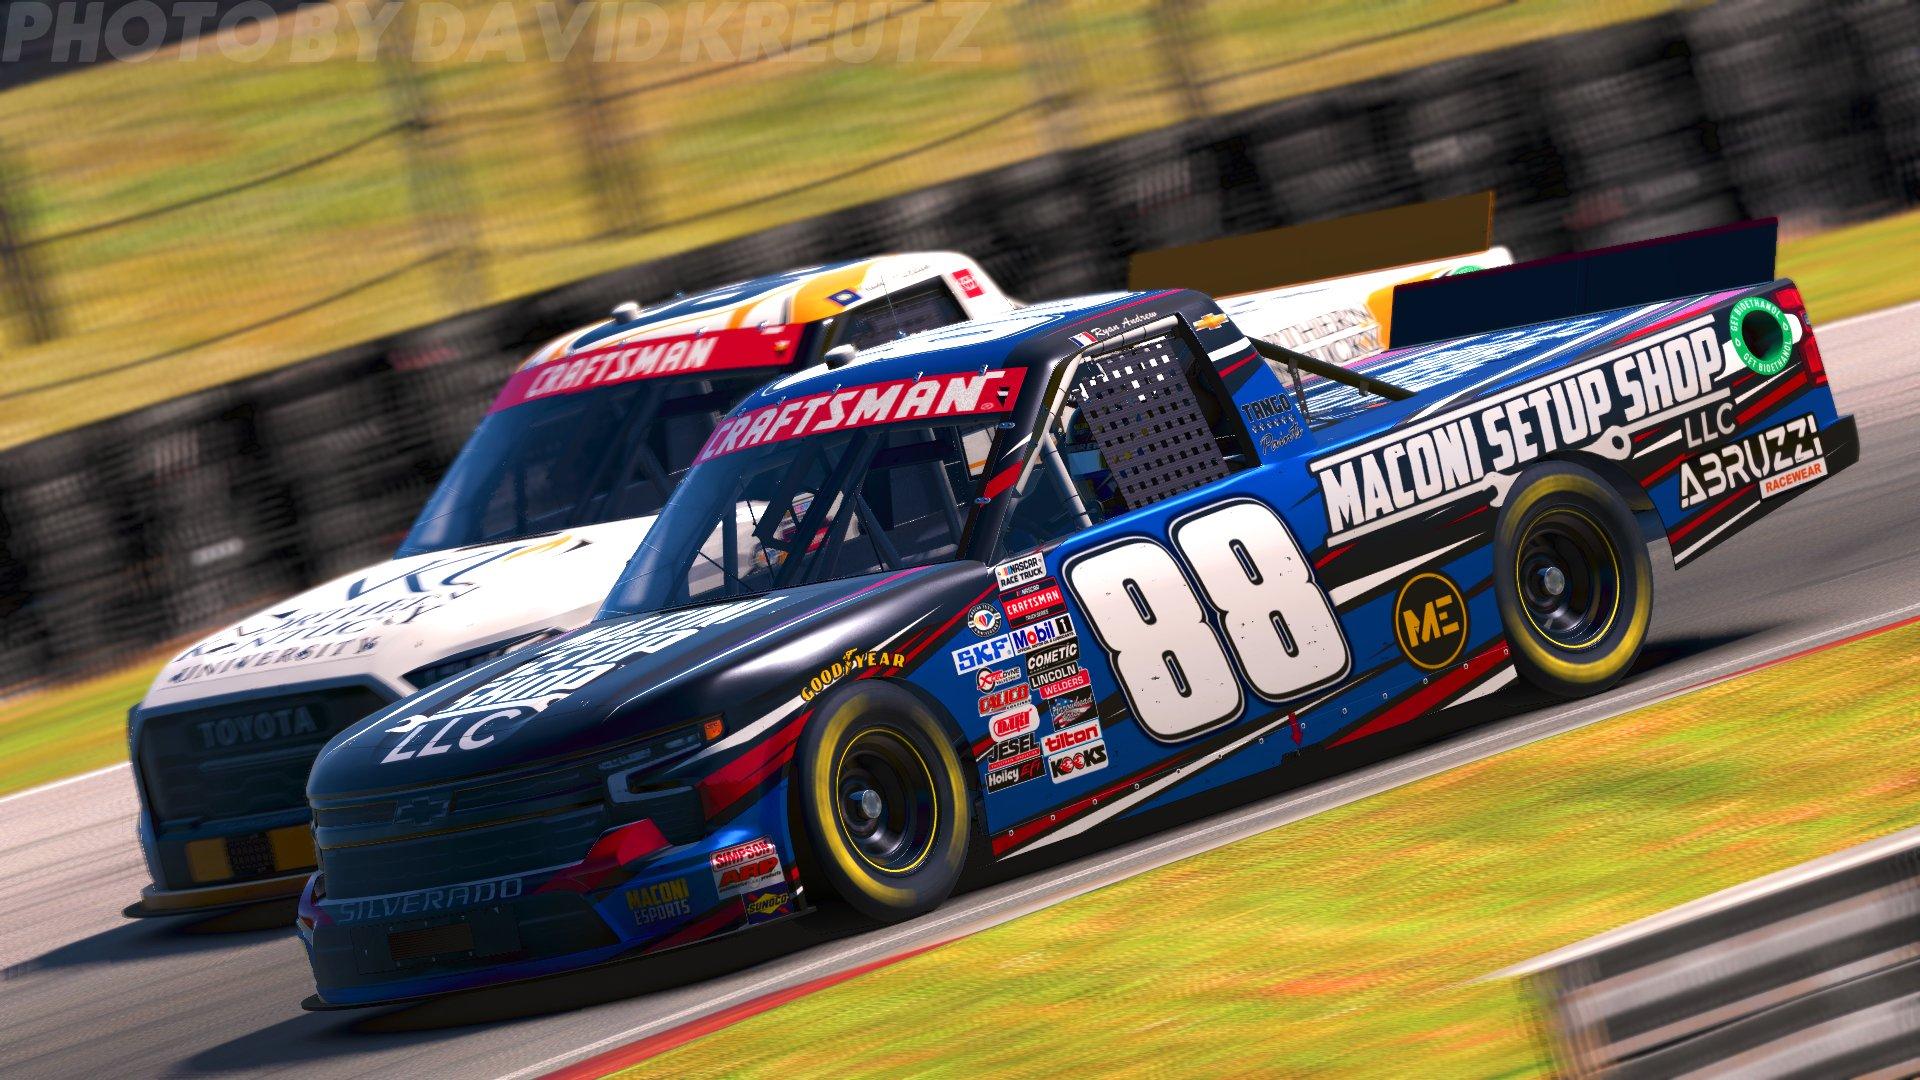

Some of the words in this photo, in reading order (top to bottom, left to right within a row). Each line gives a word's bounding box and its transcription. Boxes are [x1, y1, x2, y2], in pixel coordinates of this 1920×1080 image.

[1736, 299, 1781, 319] BIOETHANOL
[1091, 324, 1119, 339] Ryan
[1122, 311, 1157, 328] Andrew
[524, 337, 719, 399] CRAFTSMAN
[1743, 353, 1757, 367] GET
[1759, 340, 1792, 373] BIOETHANOL
[702, 370, 1005, 460] CRAFTSMAN
[1241, 393, 1292, 422] TANGO
[1320, 418, 1484, 533] MACONI
[1481, 368, 1611, 471] SETUP
[1613, 327, 1721, 422] SHOP
[1685, 402, 1736, 448] LLC
[1681, 414, 1823, 509] ABRUZZI
[1765, 463, 1822, 493] RACEWEAR
[1000, 576, 1018, 587] RACE
[1020, 567, 1043, 581] TRUCK
[1008, 557, 1038, 574] NASCAR
[1006, 590, 1059, 616] CRAFTSMAN
[1065, 500, 1349, 739] 88
[1403, 594, 1460, 647] ME
[1012, 620, 1055, 650] Mobil
[957, 637, 1008, 671] SKF
[1027, 642, 1077, 670] COMETIC
[801, 648, 905, 701] GOODYEAR
[1031, 664, 1077, 688] LINCOLN
[1045, 675, 1084, 696] WELDERS
[198, 706, 317, 748] TOYOTA
[380, 708, 521, 764] LLC
[1045, 726, 1099, 752] tilton
[987, 733, 1040, 763] JESEL
[1050, 744, 1107, 779] KOOKS
[988, 768, 1019, 786] Holley
[715, 841, 769, 863] SIMPSON
[338, 878, 522, 922] SILVERADO
[626, 879, 689, 911] MACONI
[748, 893, 788, 914] SUNOCO
[634, 899, 691, 926] ESPORTS
